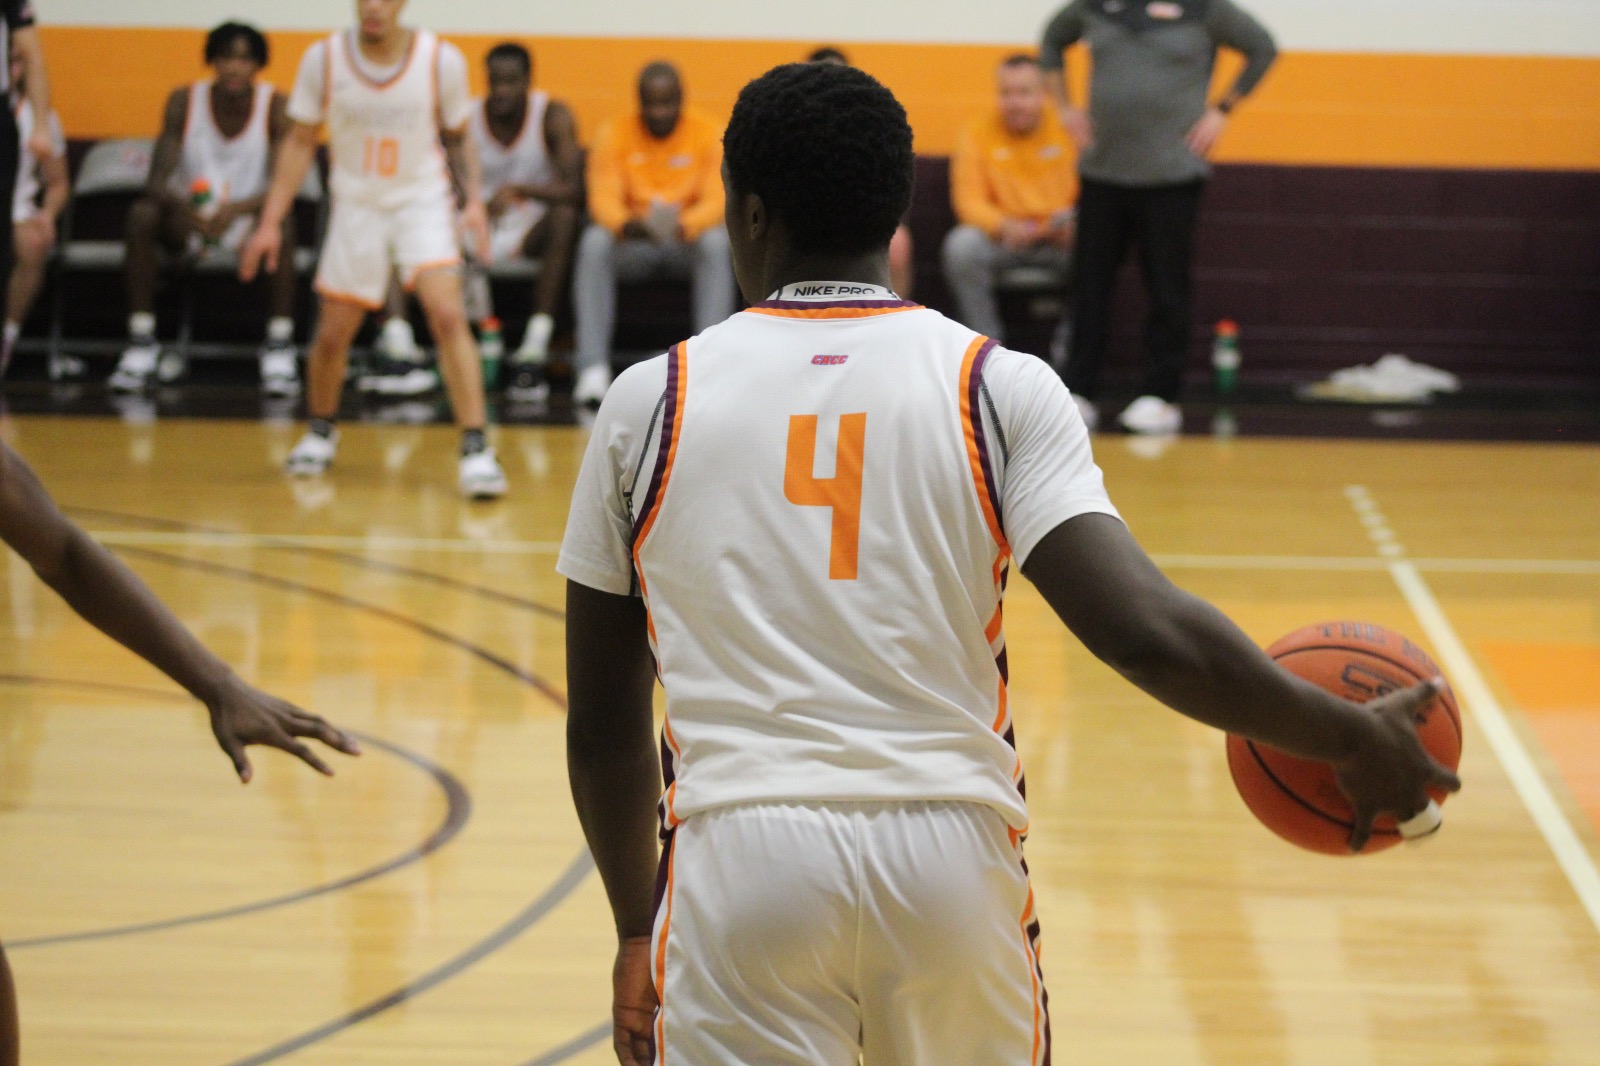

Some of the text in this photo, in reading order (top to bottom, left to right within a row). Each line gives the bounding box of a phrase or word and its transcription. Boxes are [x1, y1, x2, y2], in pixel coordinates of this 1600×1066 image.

[362, 136, 399, 177] 10
[794, 286, 876, 296] NIKE PRO
[811, 354, 848, 365] CACC
[784, 412, 867, 580] 4
